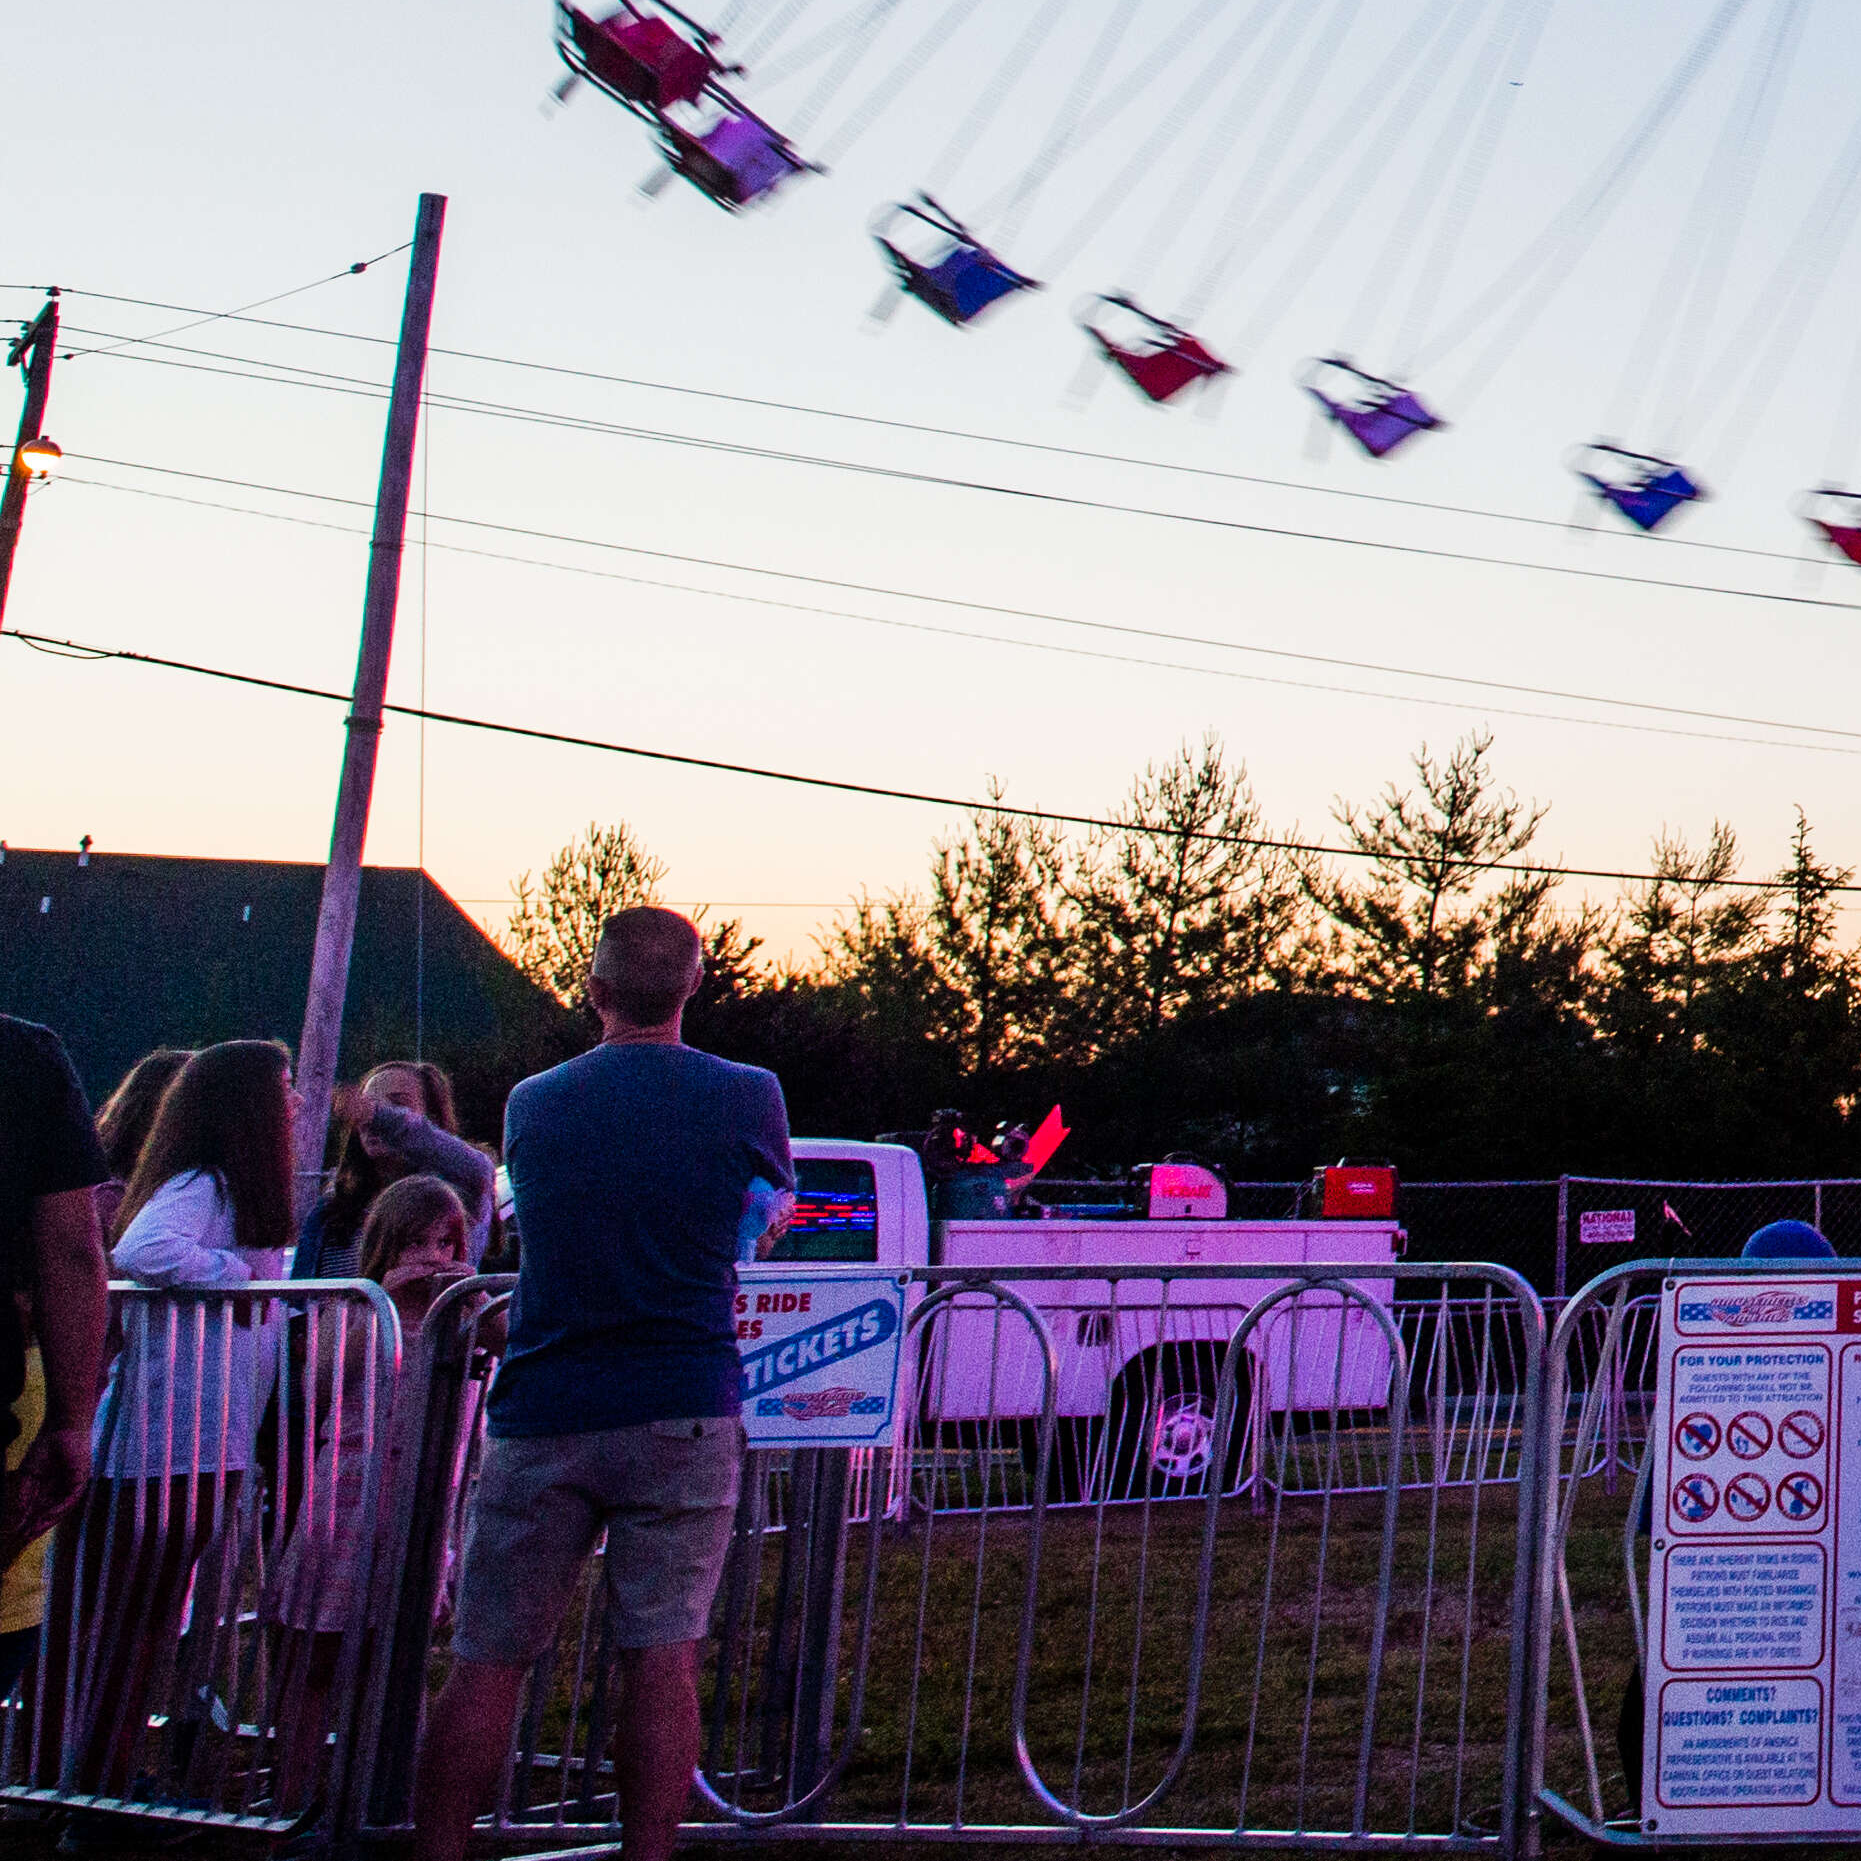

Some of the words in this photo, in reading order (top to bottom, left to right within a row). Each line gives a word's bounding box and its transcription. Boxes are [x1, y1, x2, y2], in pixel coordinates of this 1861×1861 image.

[756, 1293, 812, 1313] RIDE
[742, 1308, 881, 1390] TICKETS
[1679, 1355, 1704, 1366] FOR
[1708, 1355, 1741, 1365] YOUR
[1746, 1354, 1824, 1365] PROTECTION
[1705, 1686, 1776, 1703] COMMENTS?
[1663, 1710, 1733, 1726] QUESTIONS?
[1739, 1708, 1818, 1725] COMPLAINTS?
